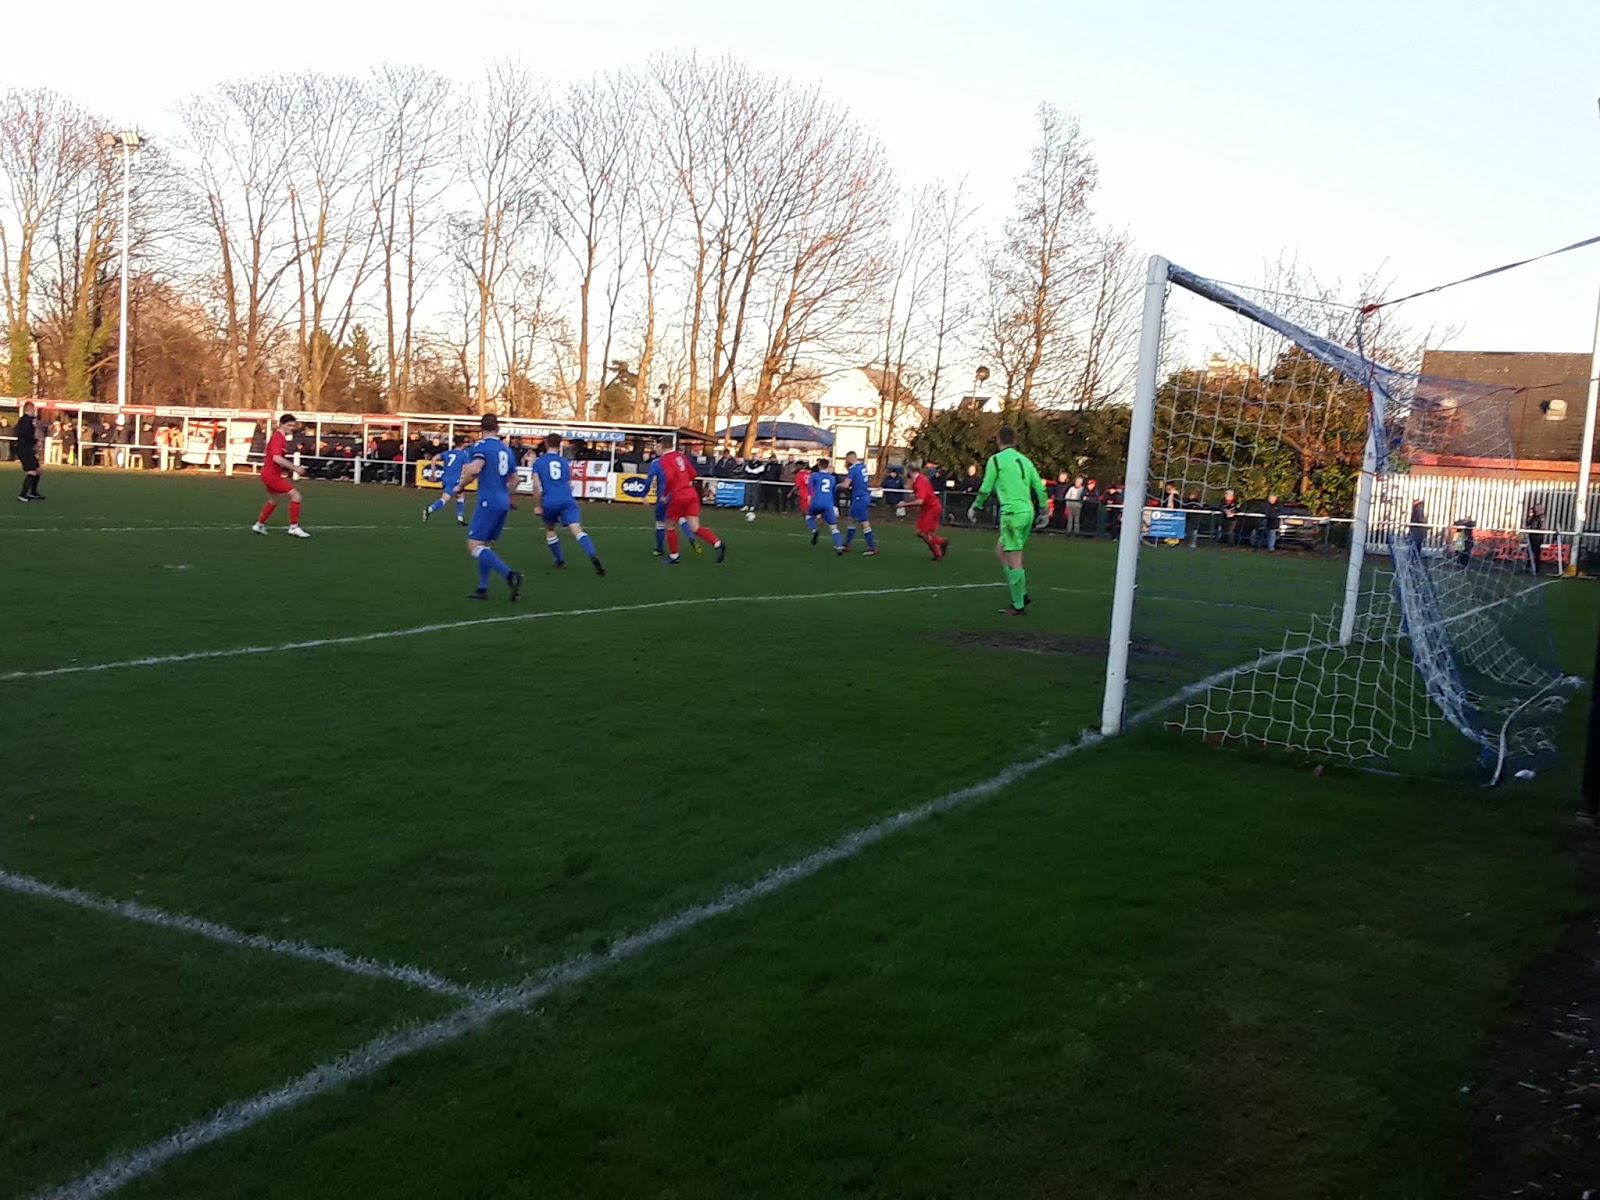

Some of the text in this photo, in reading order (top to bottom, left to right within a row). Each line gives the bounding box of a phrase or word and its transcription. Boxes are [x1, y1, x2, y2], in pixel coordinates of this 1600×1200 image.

[823, 405, 878, 418] TESCO
[571, 430, 598, 438] TOWN
[448, 454, 456, 467] 7
[498, 451, 509, 476] 8
[675, 456, 686, 472] 9
[549, 460, 562, 480] 6
[1015, 458, 1025, 480] 1
[821, 478, 831, 493] 2
